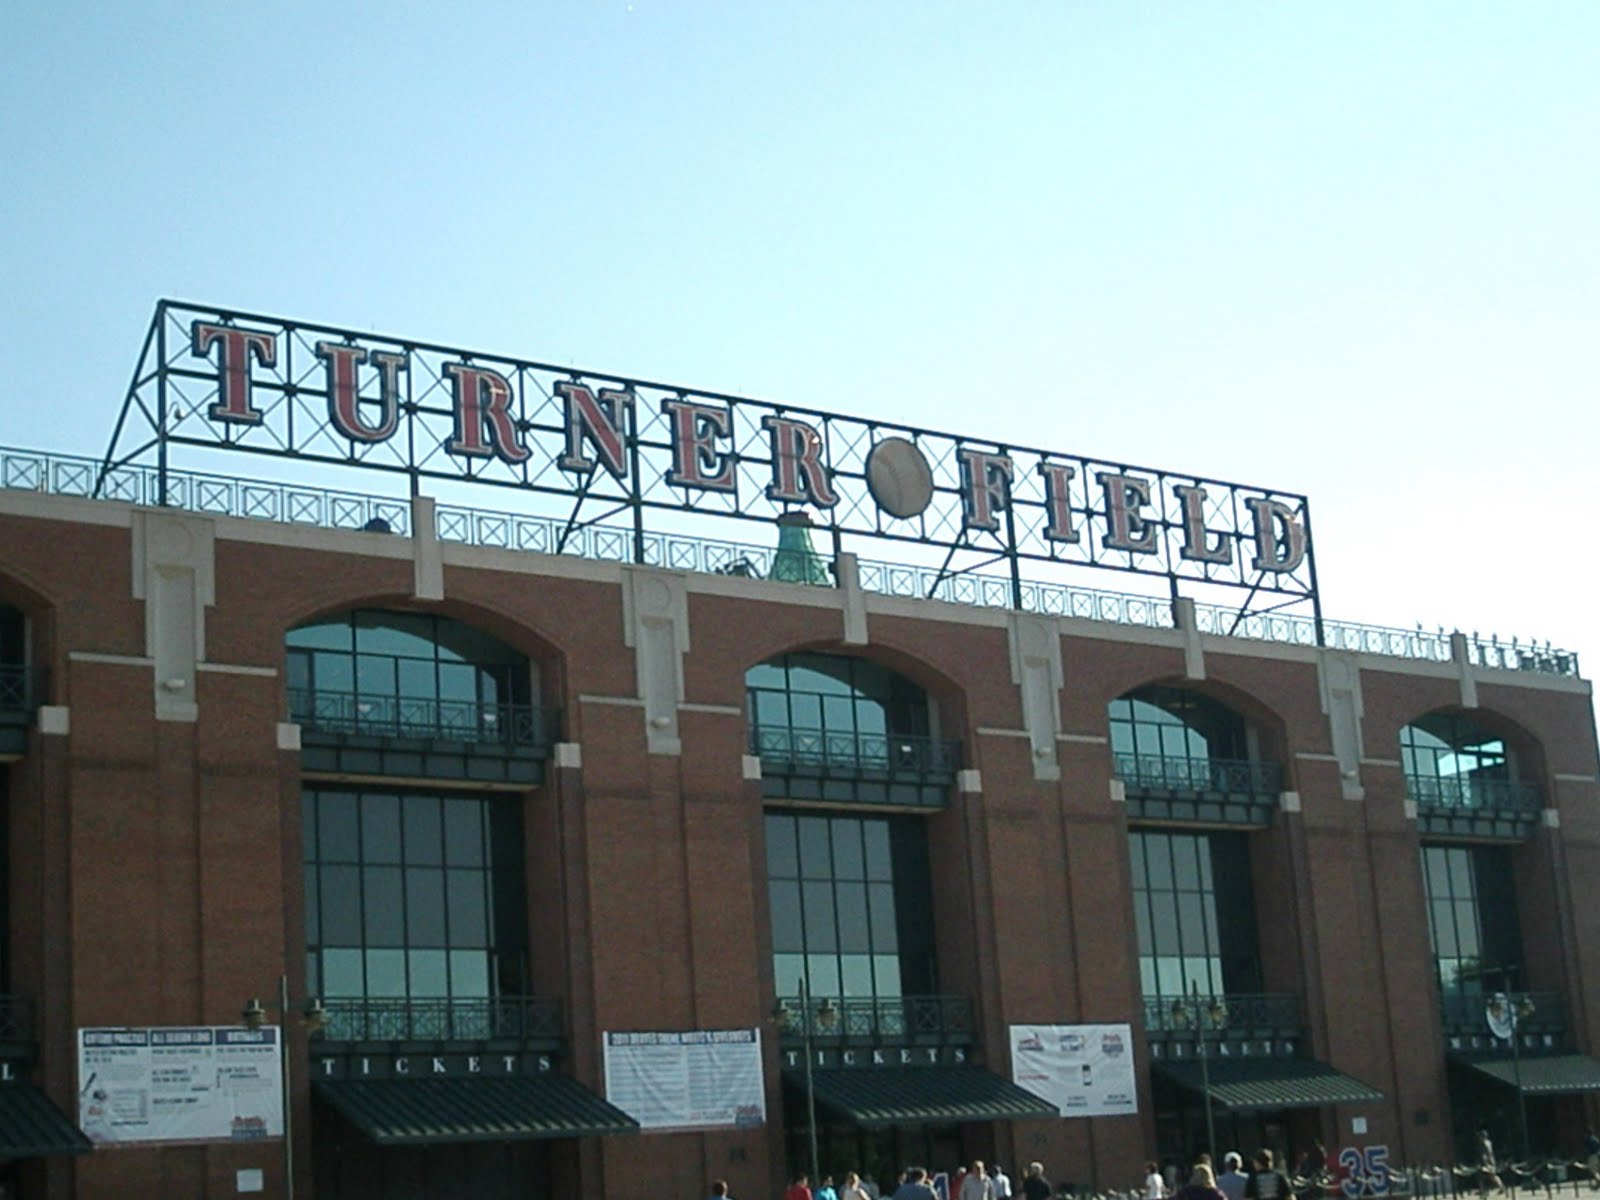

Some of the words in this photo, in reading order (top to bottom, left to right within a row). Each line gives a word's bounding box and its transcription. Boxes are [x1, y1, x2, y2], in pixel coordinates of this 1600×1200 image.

[191, 319, 839, 510] TURNER
[958, 447, 1308, 574] FIELD
[322, 1056, 551, 1075] TICKETS
[787, 1049, 965, 1067] TICKETS
[1339, 1145, 1390, 1199] 35
